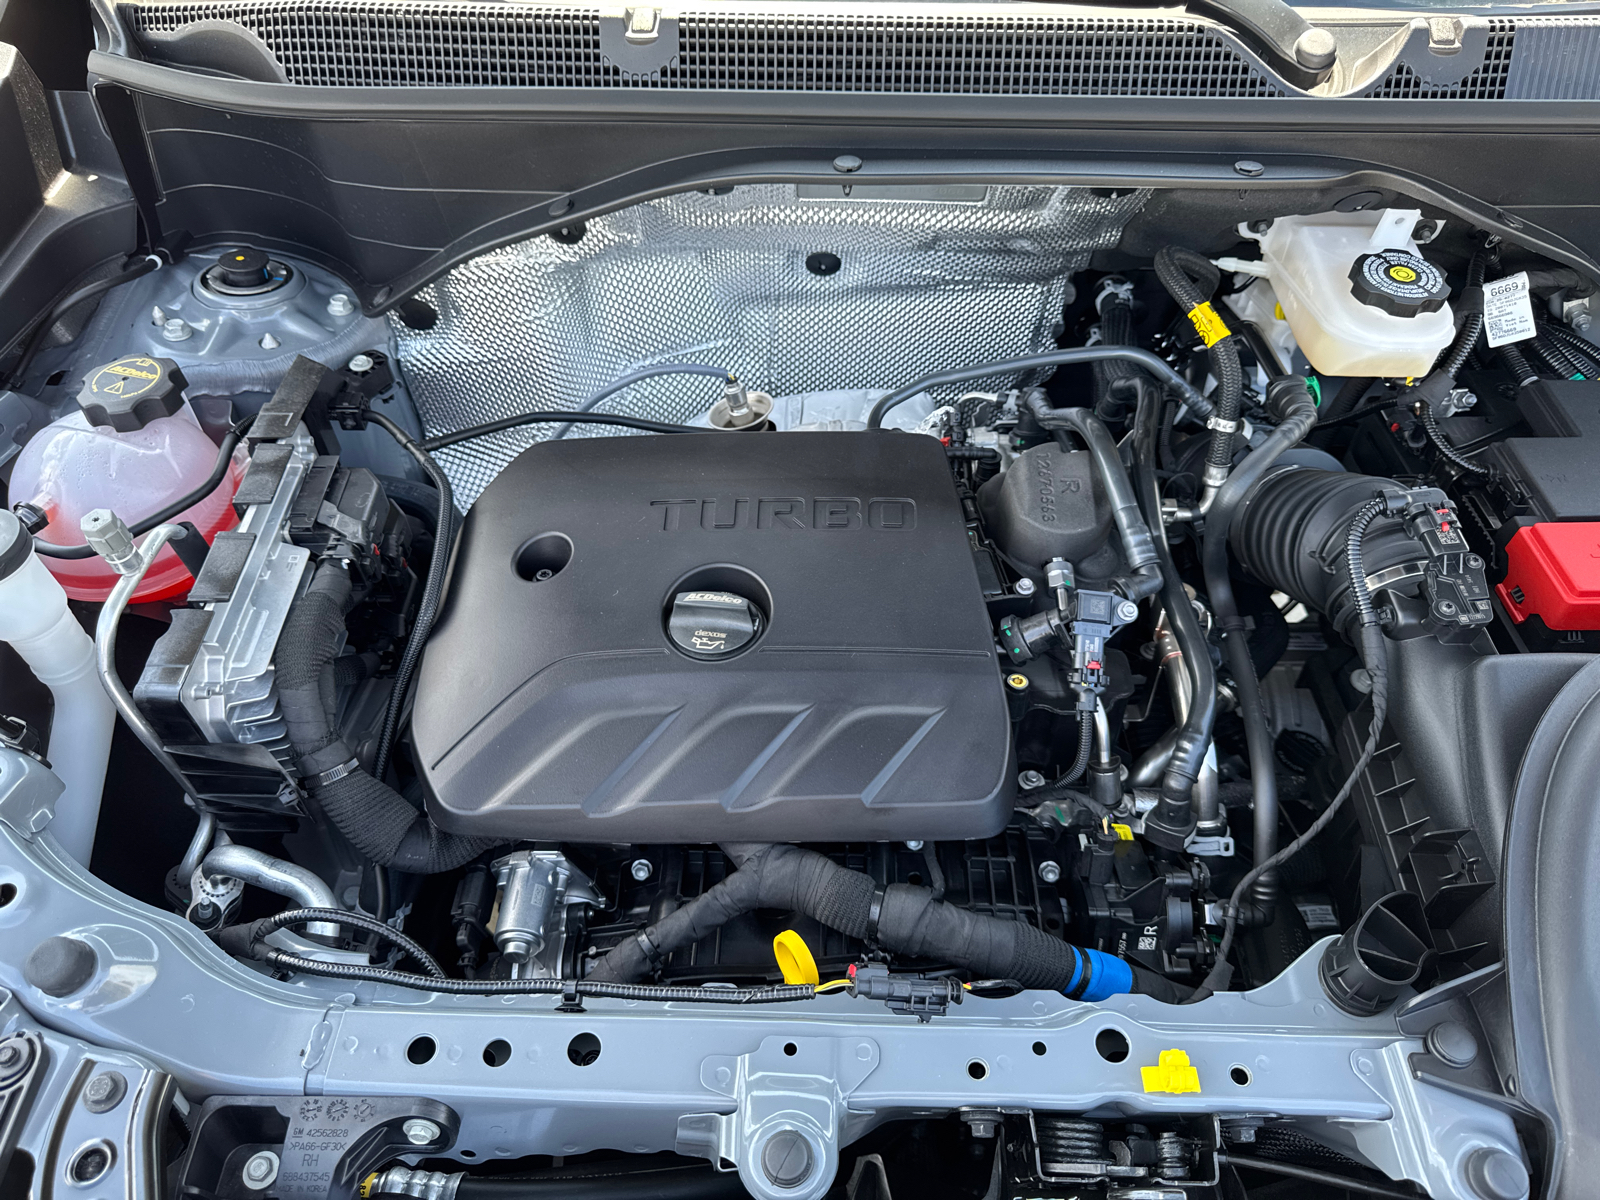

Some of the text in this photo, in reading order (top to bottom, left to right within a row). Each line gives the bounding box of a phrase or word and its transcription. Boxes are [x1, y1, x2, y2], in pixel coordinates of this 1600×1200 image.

[1490, 281, 1519, 297] 6669
[1060, 477, 1081, 494] R
[650, 497, 917, 531] TURBO
[683, 593, 743, 604] ACDelco
[694, 629, 728, 639] dexos
[1144, 925, 1158, 935] R
[293, 1127, 349, 1138] GM 42562828
[302, 1154, 319, 1166] RH
[283, 1172, 331, 1181] 688437545
[276, 1185, 294, 1193] MADE
